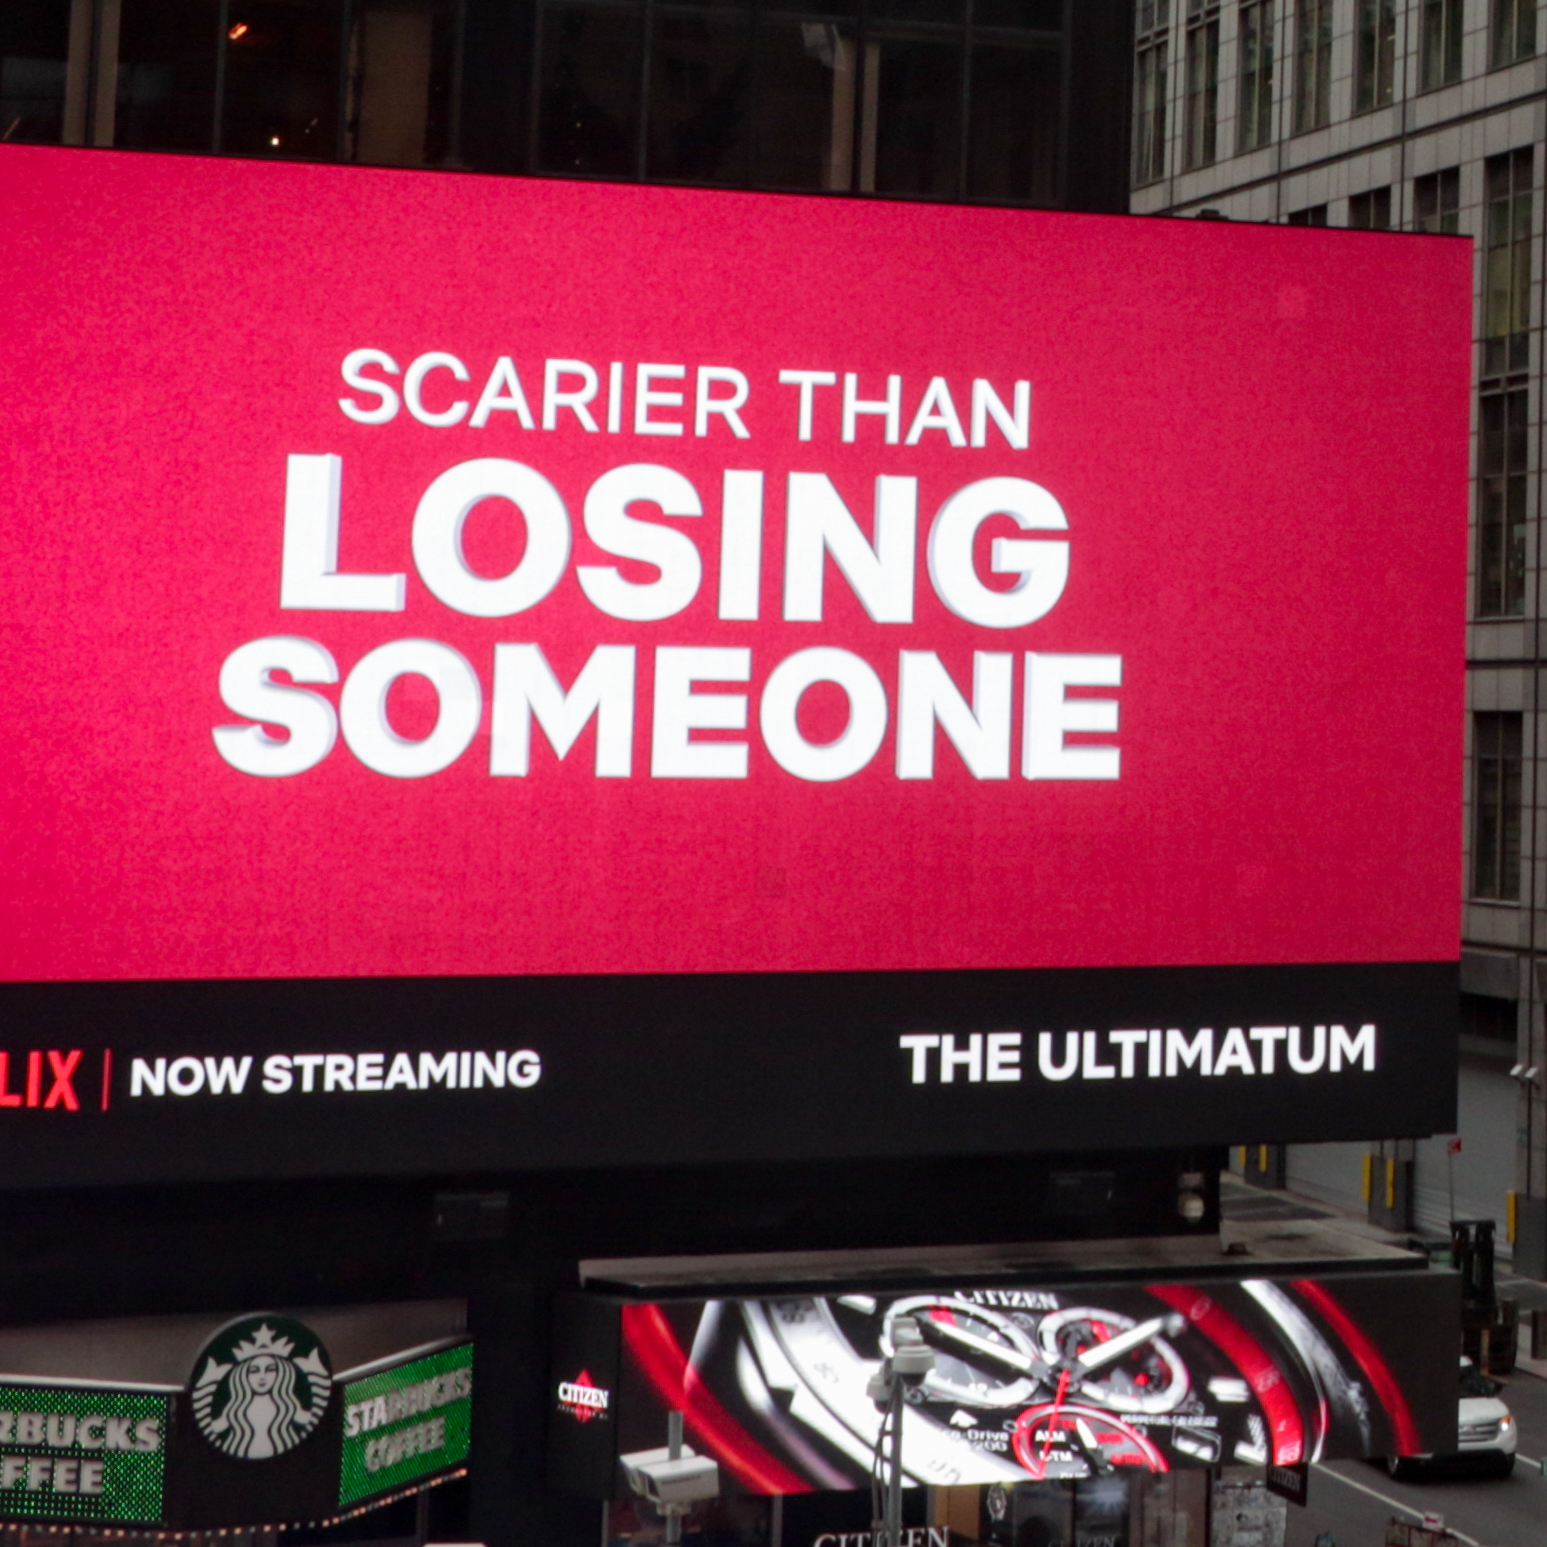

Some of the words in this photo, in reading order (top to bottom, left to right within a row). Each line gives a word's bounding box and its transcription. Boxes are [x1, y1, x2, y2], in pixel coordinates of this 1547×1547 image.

[337, 348, 752, 439] SCARIER
[779, 367, 1032, 450] THAN
[279, 452, 1071, 629] LOSING
[211, 635, 1123, 782] SOMEONE
[130, 1056, 253, 1097] NOW
[262, 1050, 541, 1094] STREAMING
[899, 1033, 1022, 1084] THE
[1038, 1024, 1376, 1081] ULTIMATUM
[955, 1290, 1059, 1310] CITIZEN
[346, 1366, 472, 1439] STARBUCKS
[557, 1381, 609, 1410] CITIZEN
[365, 1417, 444, 1473] COFFEE
